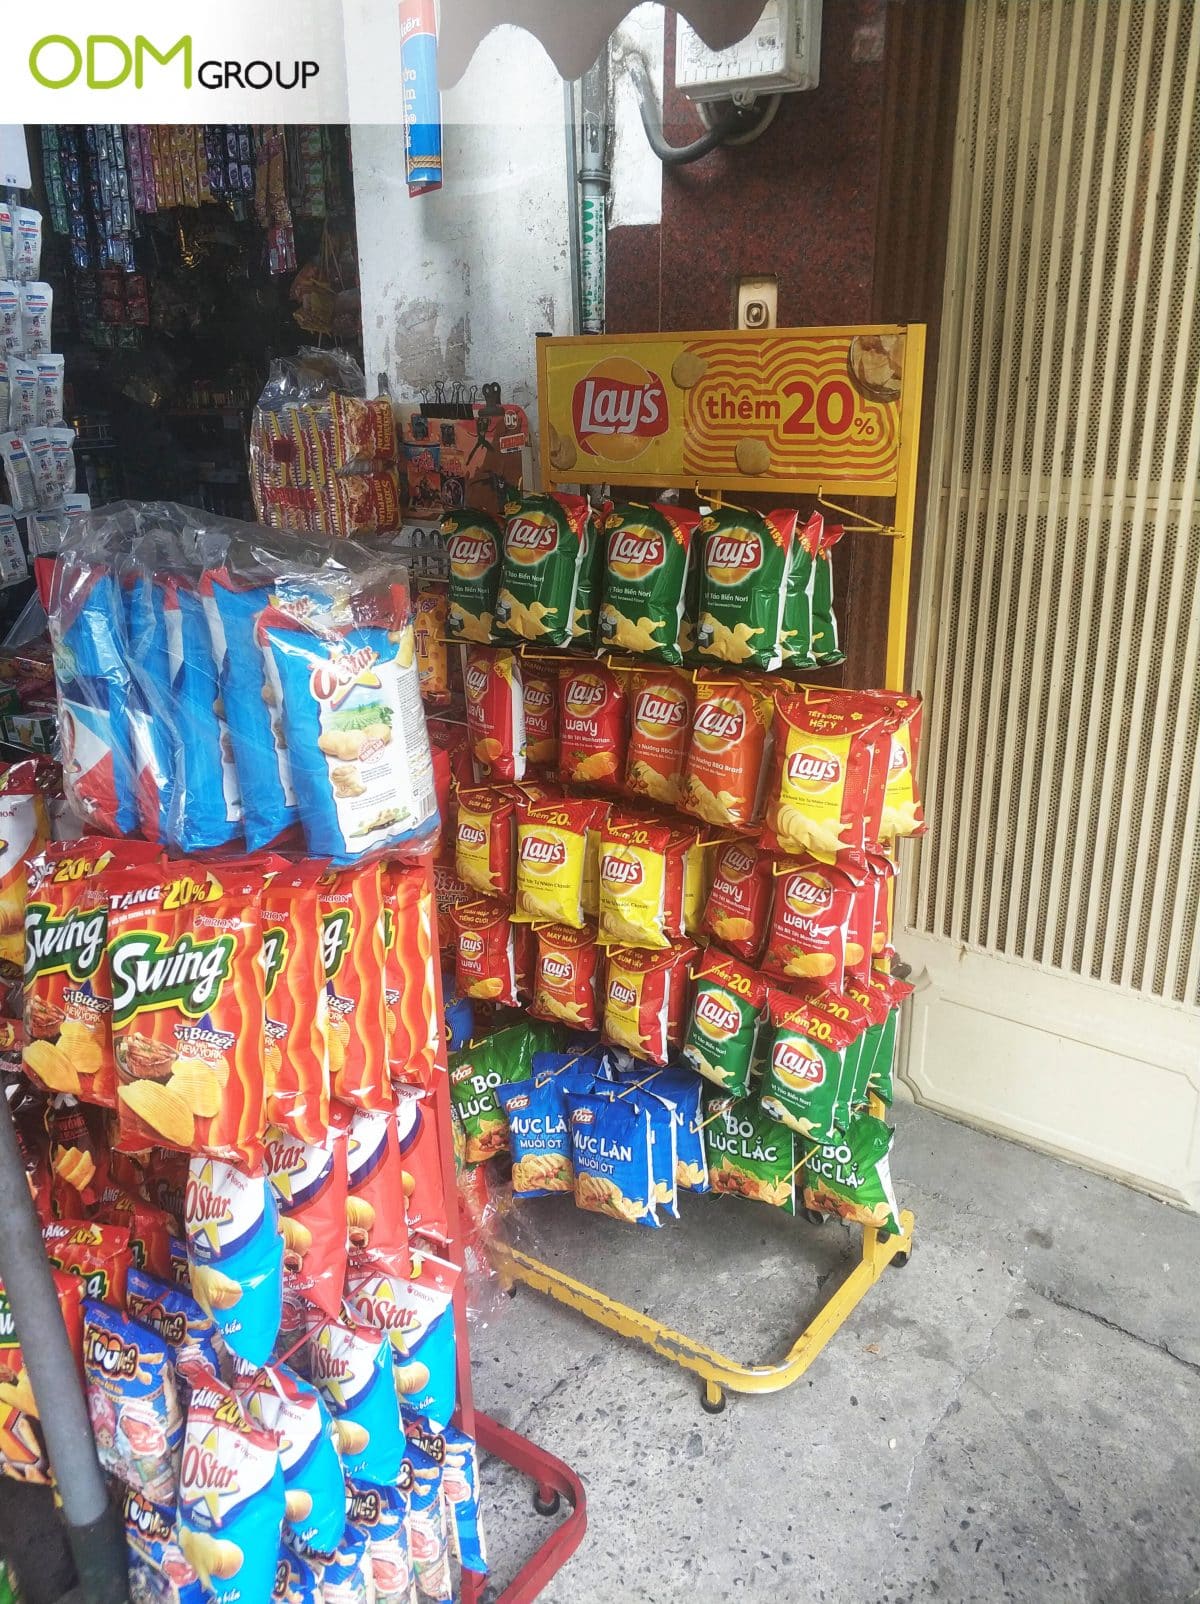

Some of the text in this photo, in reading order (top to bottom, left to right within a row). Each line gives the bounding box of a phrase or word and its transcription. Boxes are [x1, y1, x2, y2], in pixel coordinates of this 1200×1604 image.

[580, 380, 661, 434] Lay's
[706, 381, 875, 435] thêm 20%
[507, 519, 556, 549] Lay's
[610, 532, 662, 564] Lay's
[708, 538, 759, 568] Lay's
[567, 681, 603, 705] Lay's
[637, 693, 685, 725] Lay's
[694, 705, 742, 737] Lay's
[565, 719, 598, 736] wavy
[790, 753, 838, 780] Lay's
[458, 825, 485, 842] Lay's
[521, 837, 563, 863] Lay's
[602, 856, 640, 883] Lay's
[109, 877, 206, 911] TẶNG 20%
[713, 878, 743, 903] wavy
[788, 877, 830, 904] Lay's
[783, 911, 819, 938] wavy
[24, 911, 105, 973] Swing
[459, 937, 482, 952] Lay's
[113, 942, 226, 1011] Swing
[543, 957, 571, 979] Lay's
[610, 981, 636, 1003] Lay's
[697, 995, 740, 1034] Lay's
[774, 1044, 822, 1078] Lay's
[471, 1069, 501, 1094] BÒ
[458, 1095, 492, 1120] LÚC
[726, 1114, 754, 1137] BÒ
[709, 1130, 738, 1153] LÚC
[263, 1139, 305, 1176] Star
[191, 1387, 224, 1410] TẶNG
[181, 1445, 238, 1490] O'Star
